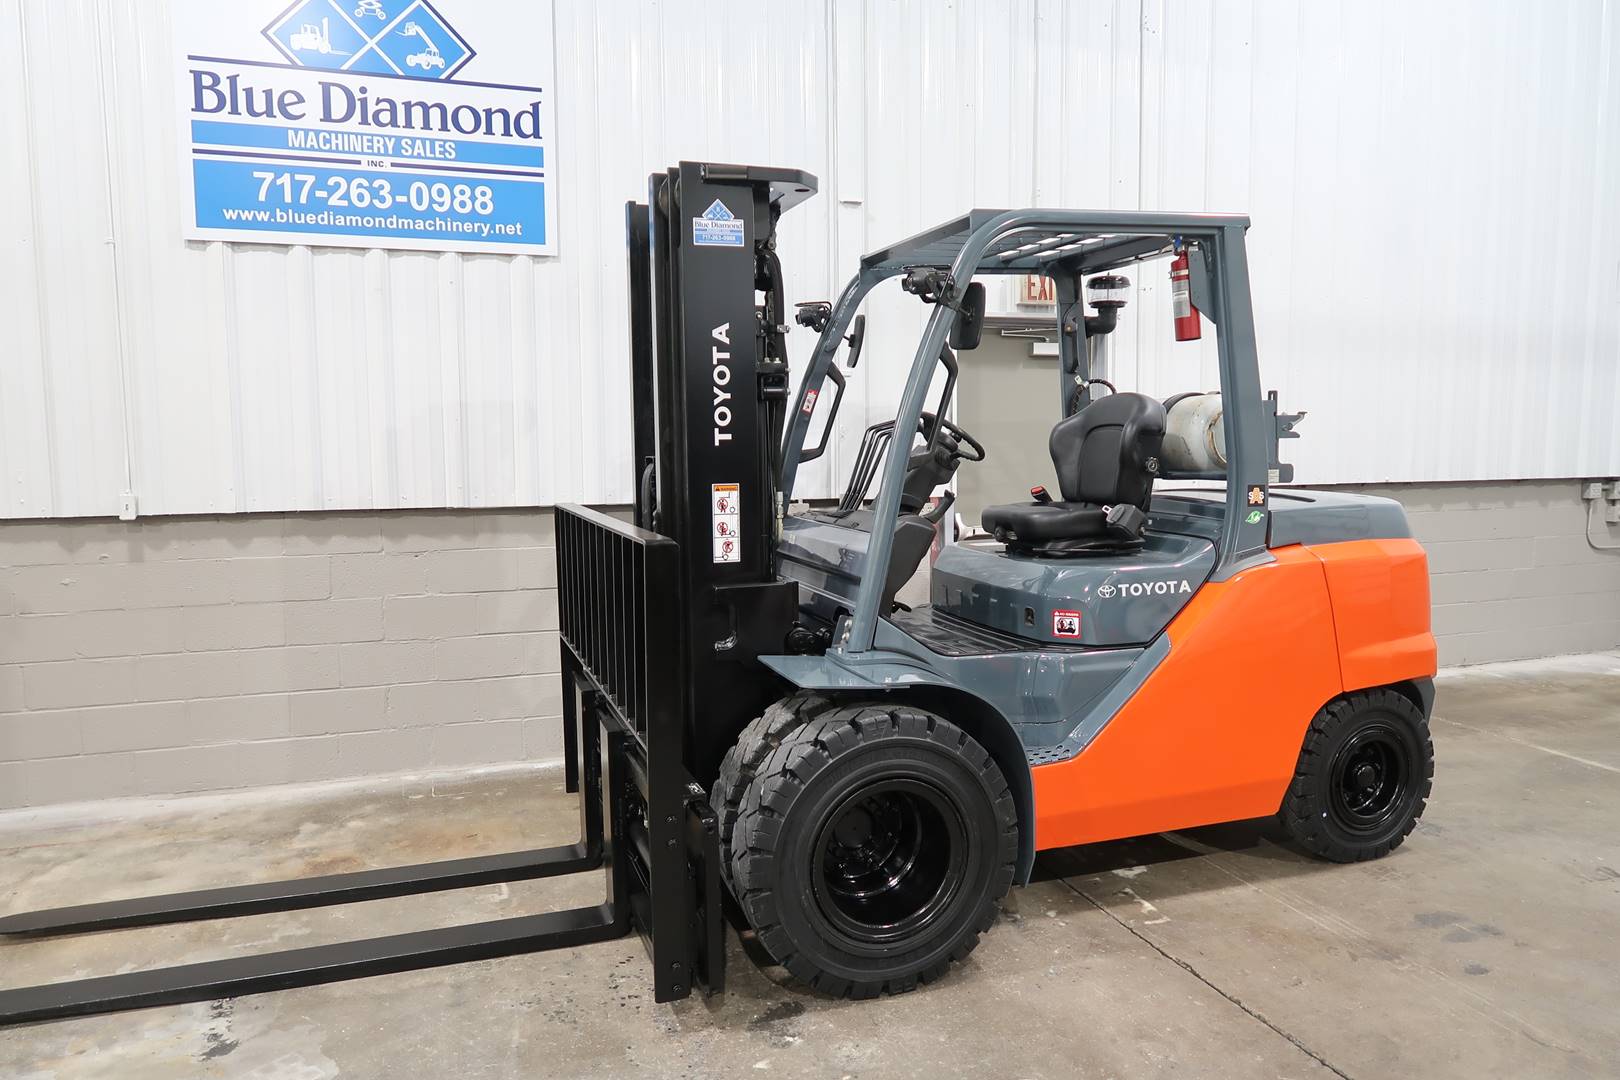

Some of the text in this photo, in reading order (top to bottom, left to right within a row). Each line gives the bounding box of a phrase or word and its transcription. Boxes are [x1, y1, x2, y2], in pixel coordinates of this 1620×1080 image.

[189, 69, 543, 139] Blue Diamond
[287, 129, 457, 159] MACHINERY SALES
[366, 159, 388, 169] INC.
[252, 171, 494, 215] 717-263-0988
[222, 208, 523, 236] www.bluediamondmachinery.net
[1027, 274, 1054, 301] EXI
[712, 322, 733, 446] TOYOTA
[1118, 580, 1192, 597] TOYOTA
